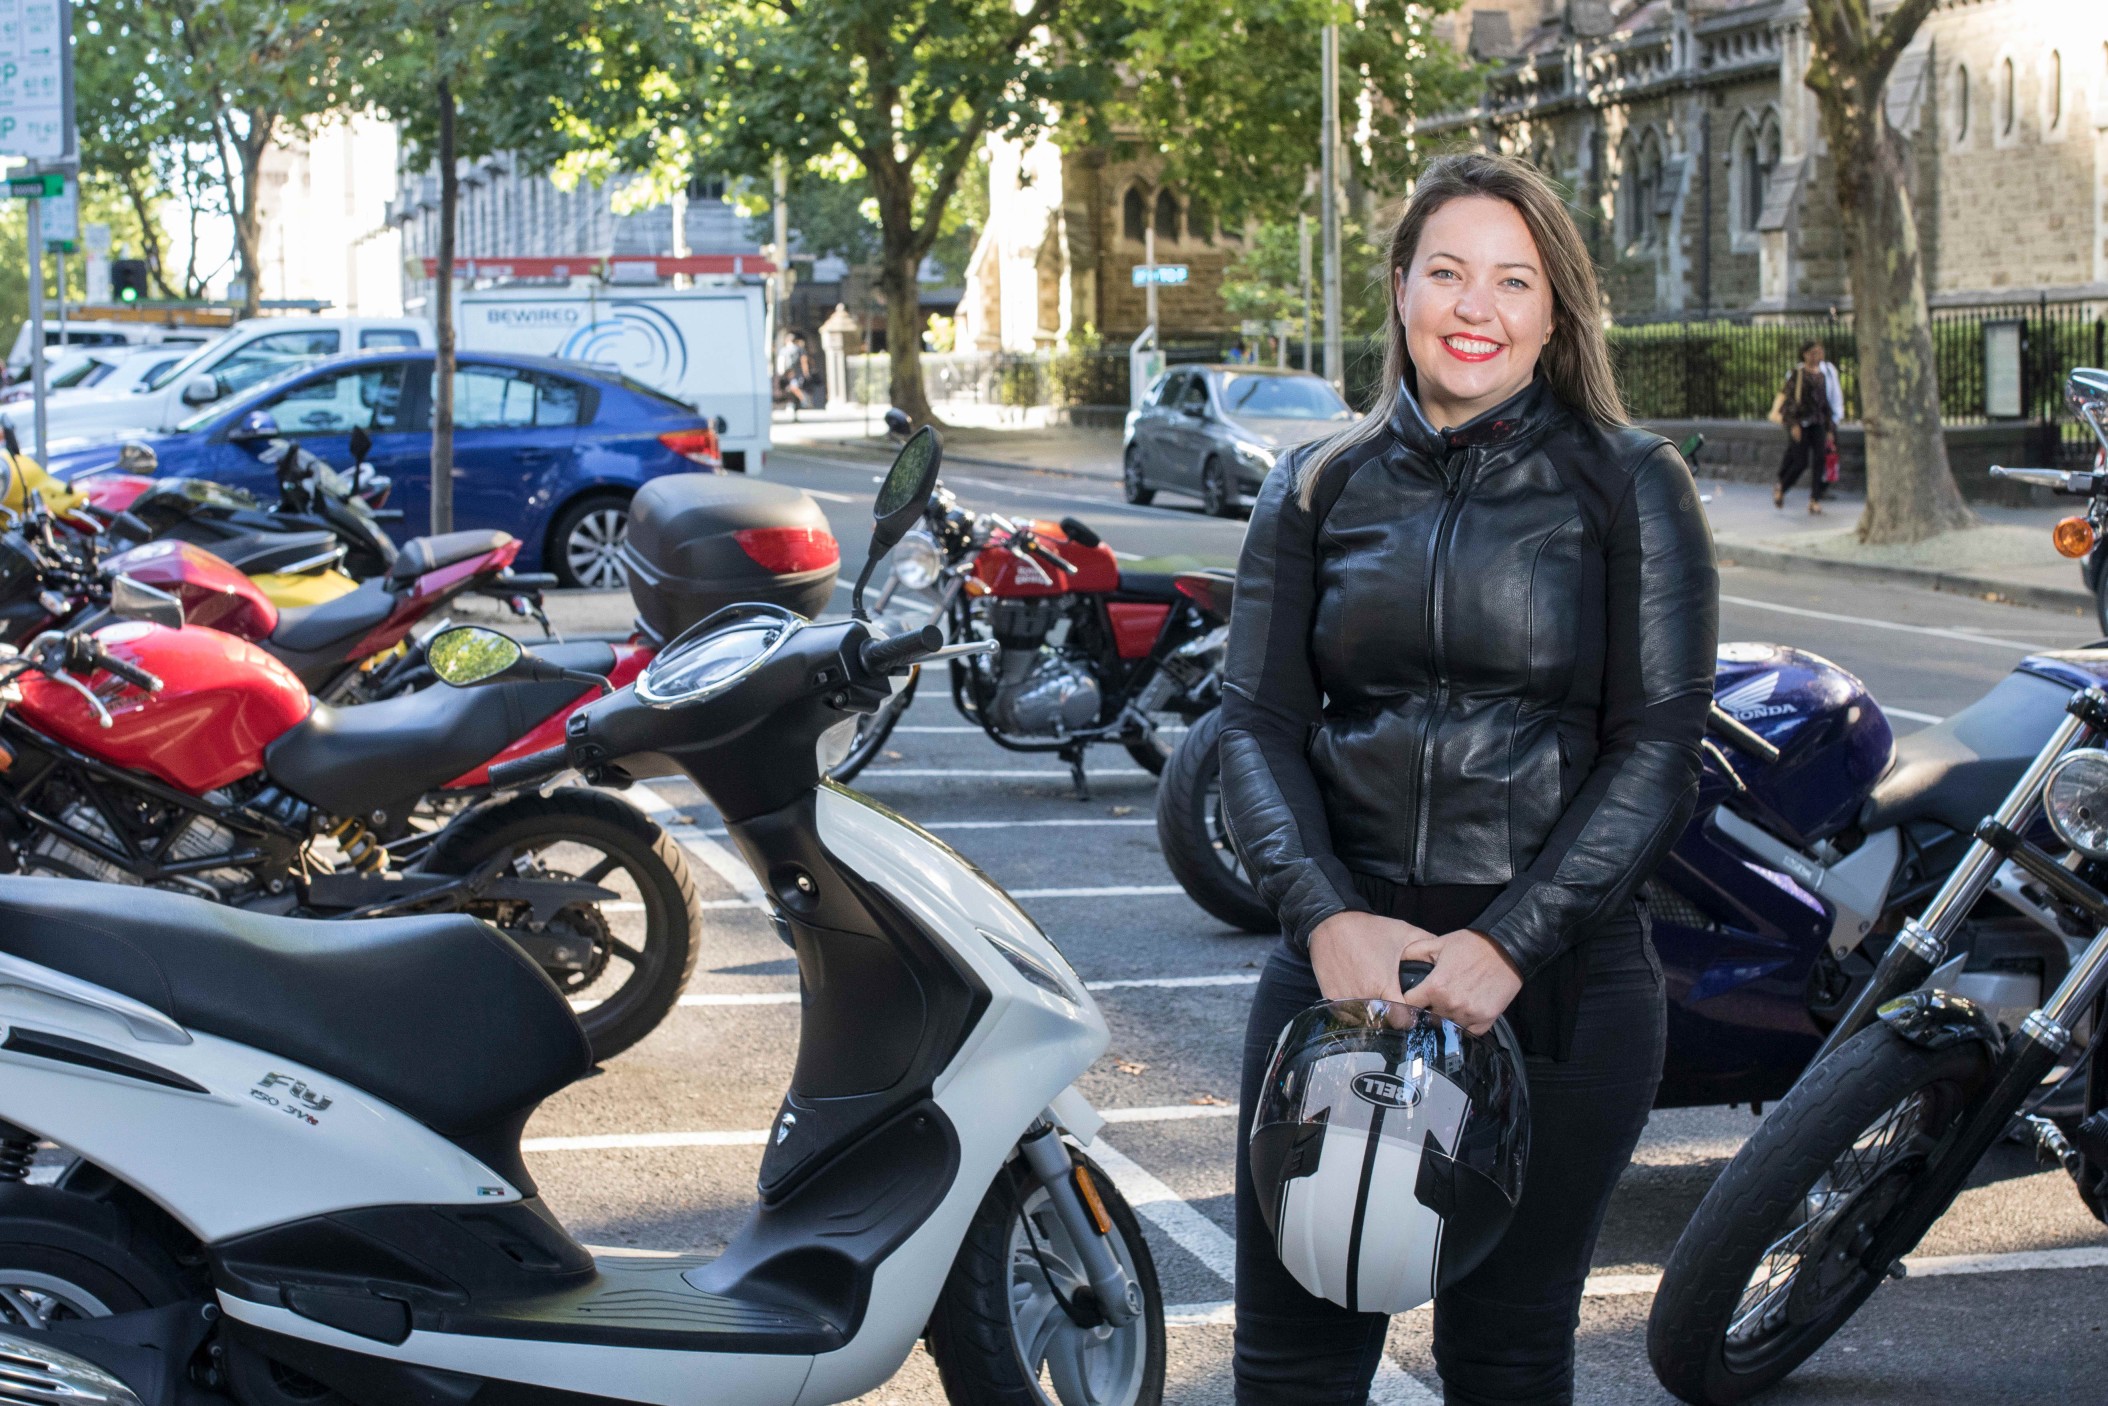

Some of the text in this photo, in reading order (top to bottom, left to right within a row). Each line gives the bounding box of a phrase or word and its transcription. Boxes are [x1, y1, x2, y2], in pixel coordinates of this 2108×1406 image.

[487, 308, 578, 323] BEWIRED
[250, 1087, 280, 1106] 150
[258, 1071, 334, 1111] Fly
[1363, 1077, 1414, 1103] BELL
